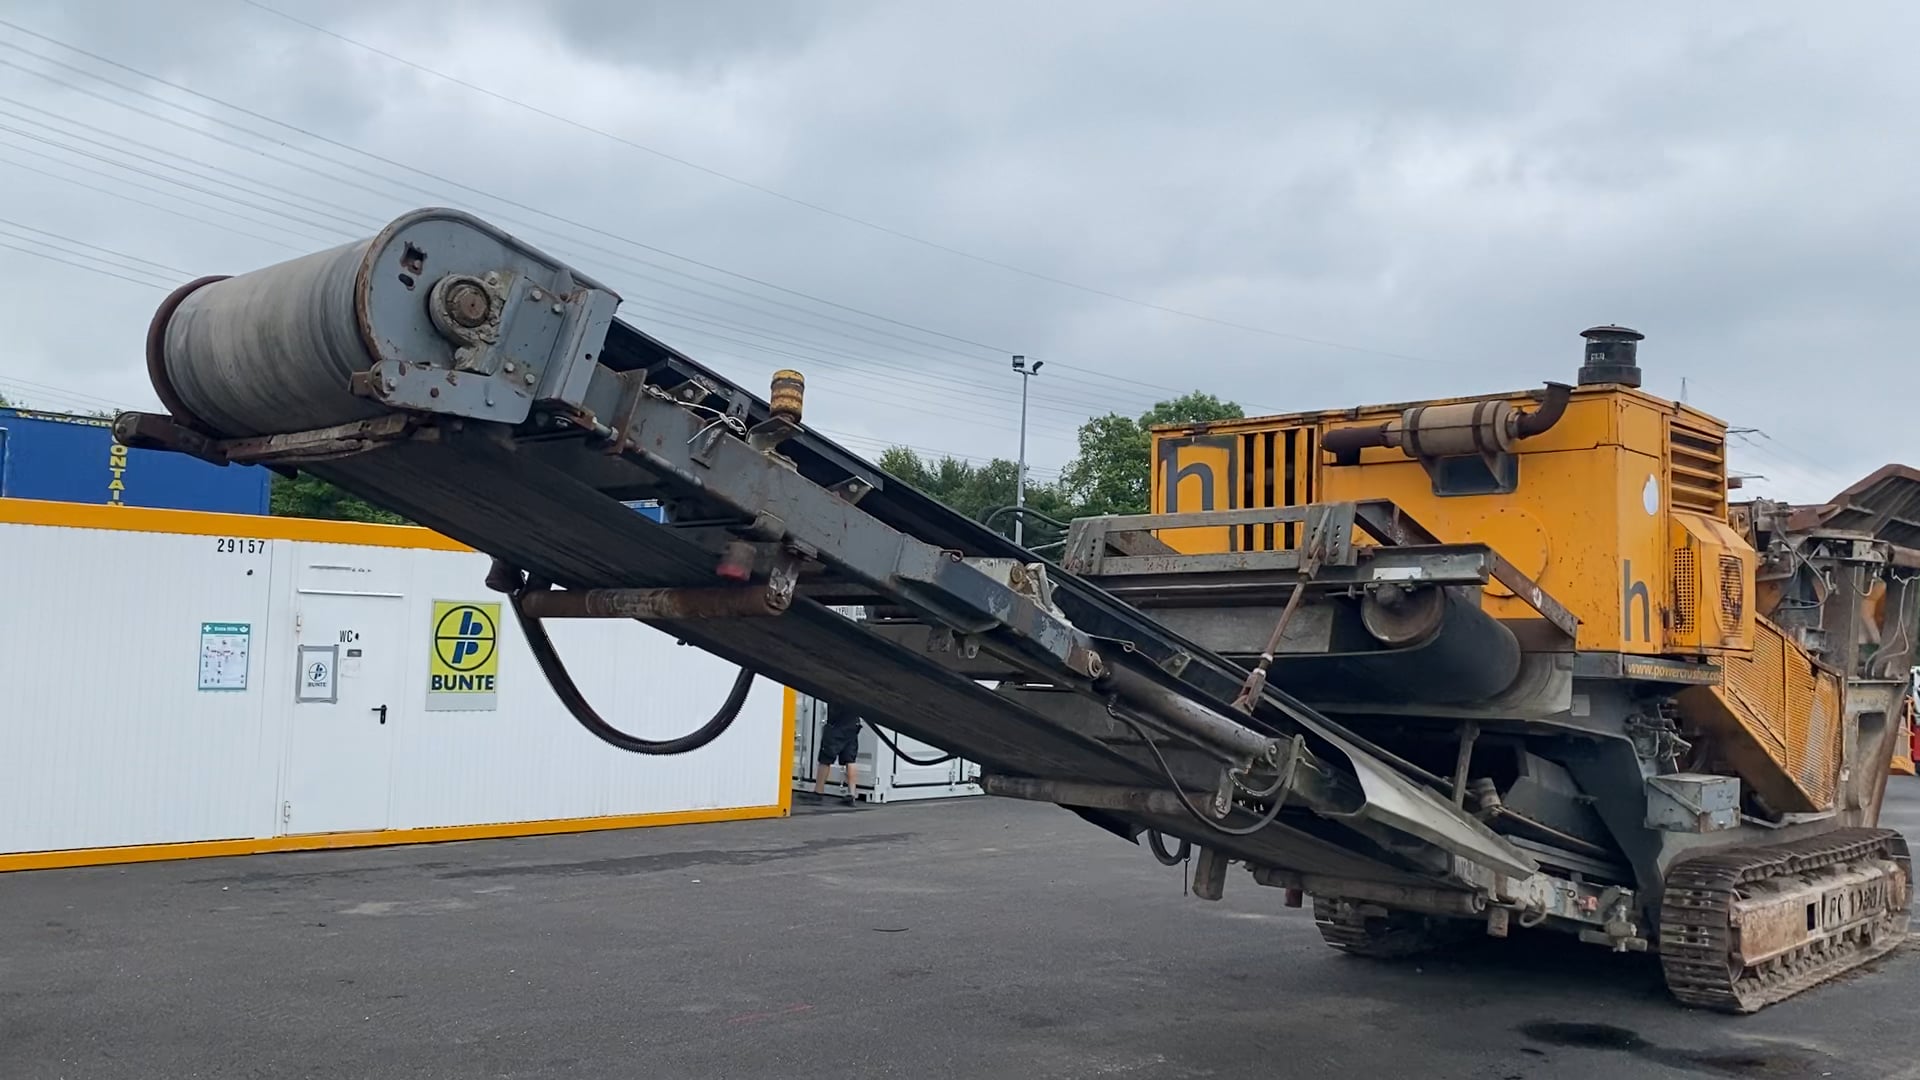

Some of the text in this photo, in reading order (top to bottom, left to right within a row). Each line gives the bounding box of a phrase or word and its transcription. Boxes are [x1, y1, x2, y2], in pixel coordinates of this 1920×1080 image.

[108, 435, 129, 506] ONTAI
[217, 538, 265, 554] 29157
[339, 629, 353, 643] WC
[1627, 662, 1720, 681] www.powercrusher.co
[431, 674, 494, 691] BUNTE
